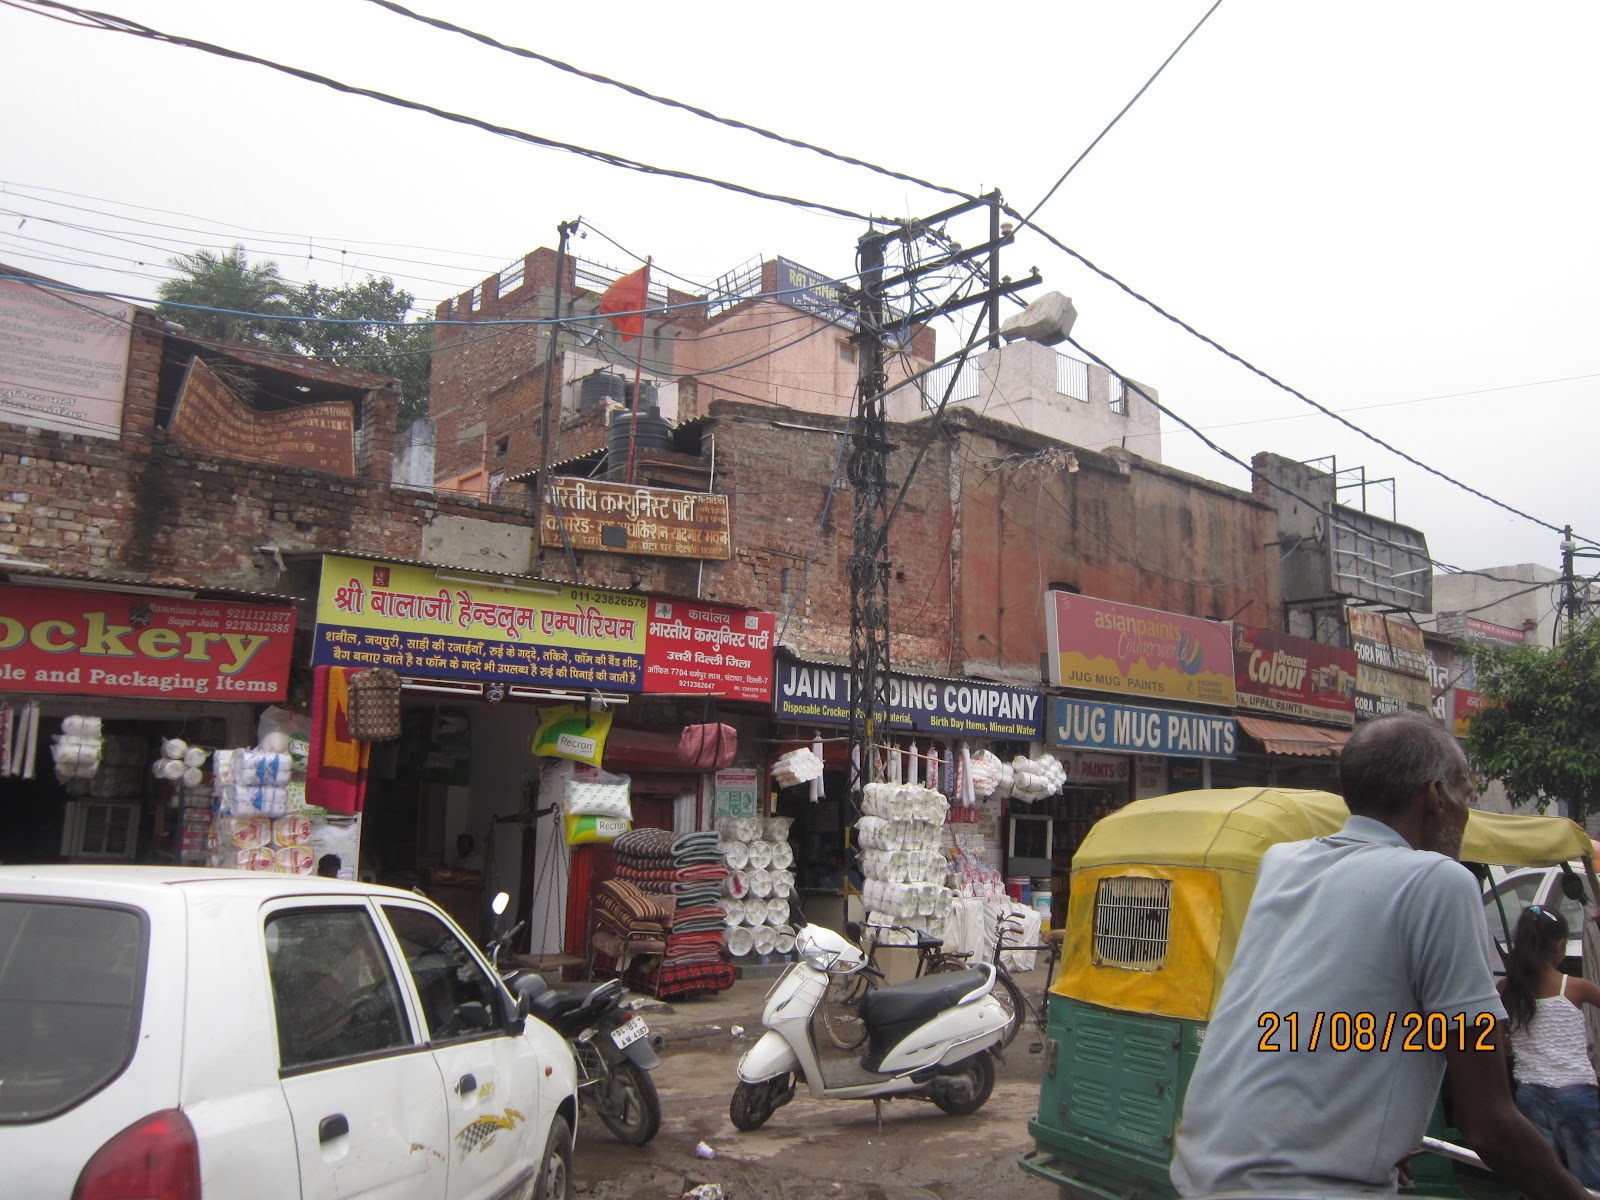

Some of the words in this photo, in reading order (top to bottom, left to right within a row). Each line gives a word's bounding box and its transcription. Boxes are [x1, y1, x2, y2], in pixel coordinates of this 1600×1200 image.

[334, 578, 363, 613] श्री
[370, 588, 452, 624] बालाजी
[457, 589, 535, 640] हैन्डलूम
[540, 604, 636, 641] एम्पोरियम
[571, 589, 647, 609] 011-23826578
[168, 616, 197, 629] Sagar
[198, 619, 219, 629] Jain
[226, 620, 290, 633] 9278312385
[199, 607, 220, 617] Jain
[227, 608, 291, 621] 9211121577
[689, 608, 731, 625] कार्यालय
[1094, 607, 1182, 641] asianpaints
[650, 620, 691, 642] भारतीय
[694, 625, 746, 652] कम्युनिस्ट
[748, 630, 769, 650] पार्टी
[432, 636, 445, 652] की
[506, 643, 516, 658] के
[595, 652, 606, 667] की
[667, 650, 692, 663] उत्तरी
[694, 653, 723, 666] दिल्ली
[726, 657, 751, 669] जिला
[1278, 649, 1307, 668] Dreamz
[1354, 642, 1375, 664] GORA
[383, 650, 403, 666] जाते
[450, 654, 459, 669] के
[484, 658, 495, 673] भी
[497, 661, 529, 676] उपलब्ध
[556, 664, 568, 679] की
[596, 667, 607, 682] की
[609, 669, 627, 684] जाती
[671, 668, 688, 676] 7704
[1248, 649, 1307, 690] Colour
[36, 667, 81, 684] and
[89, 669, 209, 693] Packaging
[216, 676, 278, 693] Items
[1068, 671, 1092, 683] JUG
[1096, 676, 1120, 686] MUG
[1127, 678, 1165, 692] PAINTS
[783, 666, 837, 701] JAIN
[843, 672, 938, 711] TDING
[944, 684, 1039, 721] COMPANY
[783, 700, 821, 717] Disposable
[822, 704, 851, 721] Crockery
[1249, 696, 1274, 710] UPPAL
[1276, 701, 1303, 714] PAINTS
[1355, 696, 1374, 713] GORA
[930, 715, 949, 728] Birth
[951, 718, 964, 731] Day
[989, 722, 1015, 735] Mineral
[1016, 725, 1036, 736] Water
[1058, 703, 1106, 744] JUG
[1113, 709, 1161, 749] MUG
[1168, 715, 1235, 755] PAINTS
[560, 735, 594, 751] Recron
[599, 820, 627, 831] Recron
